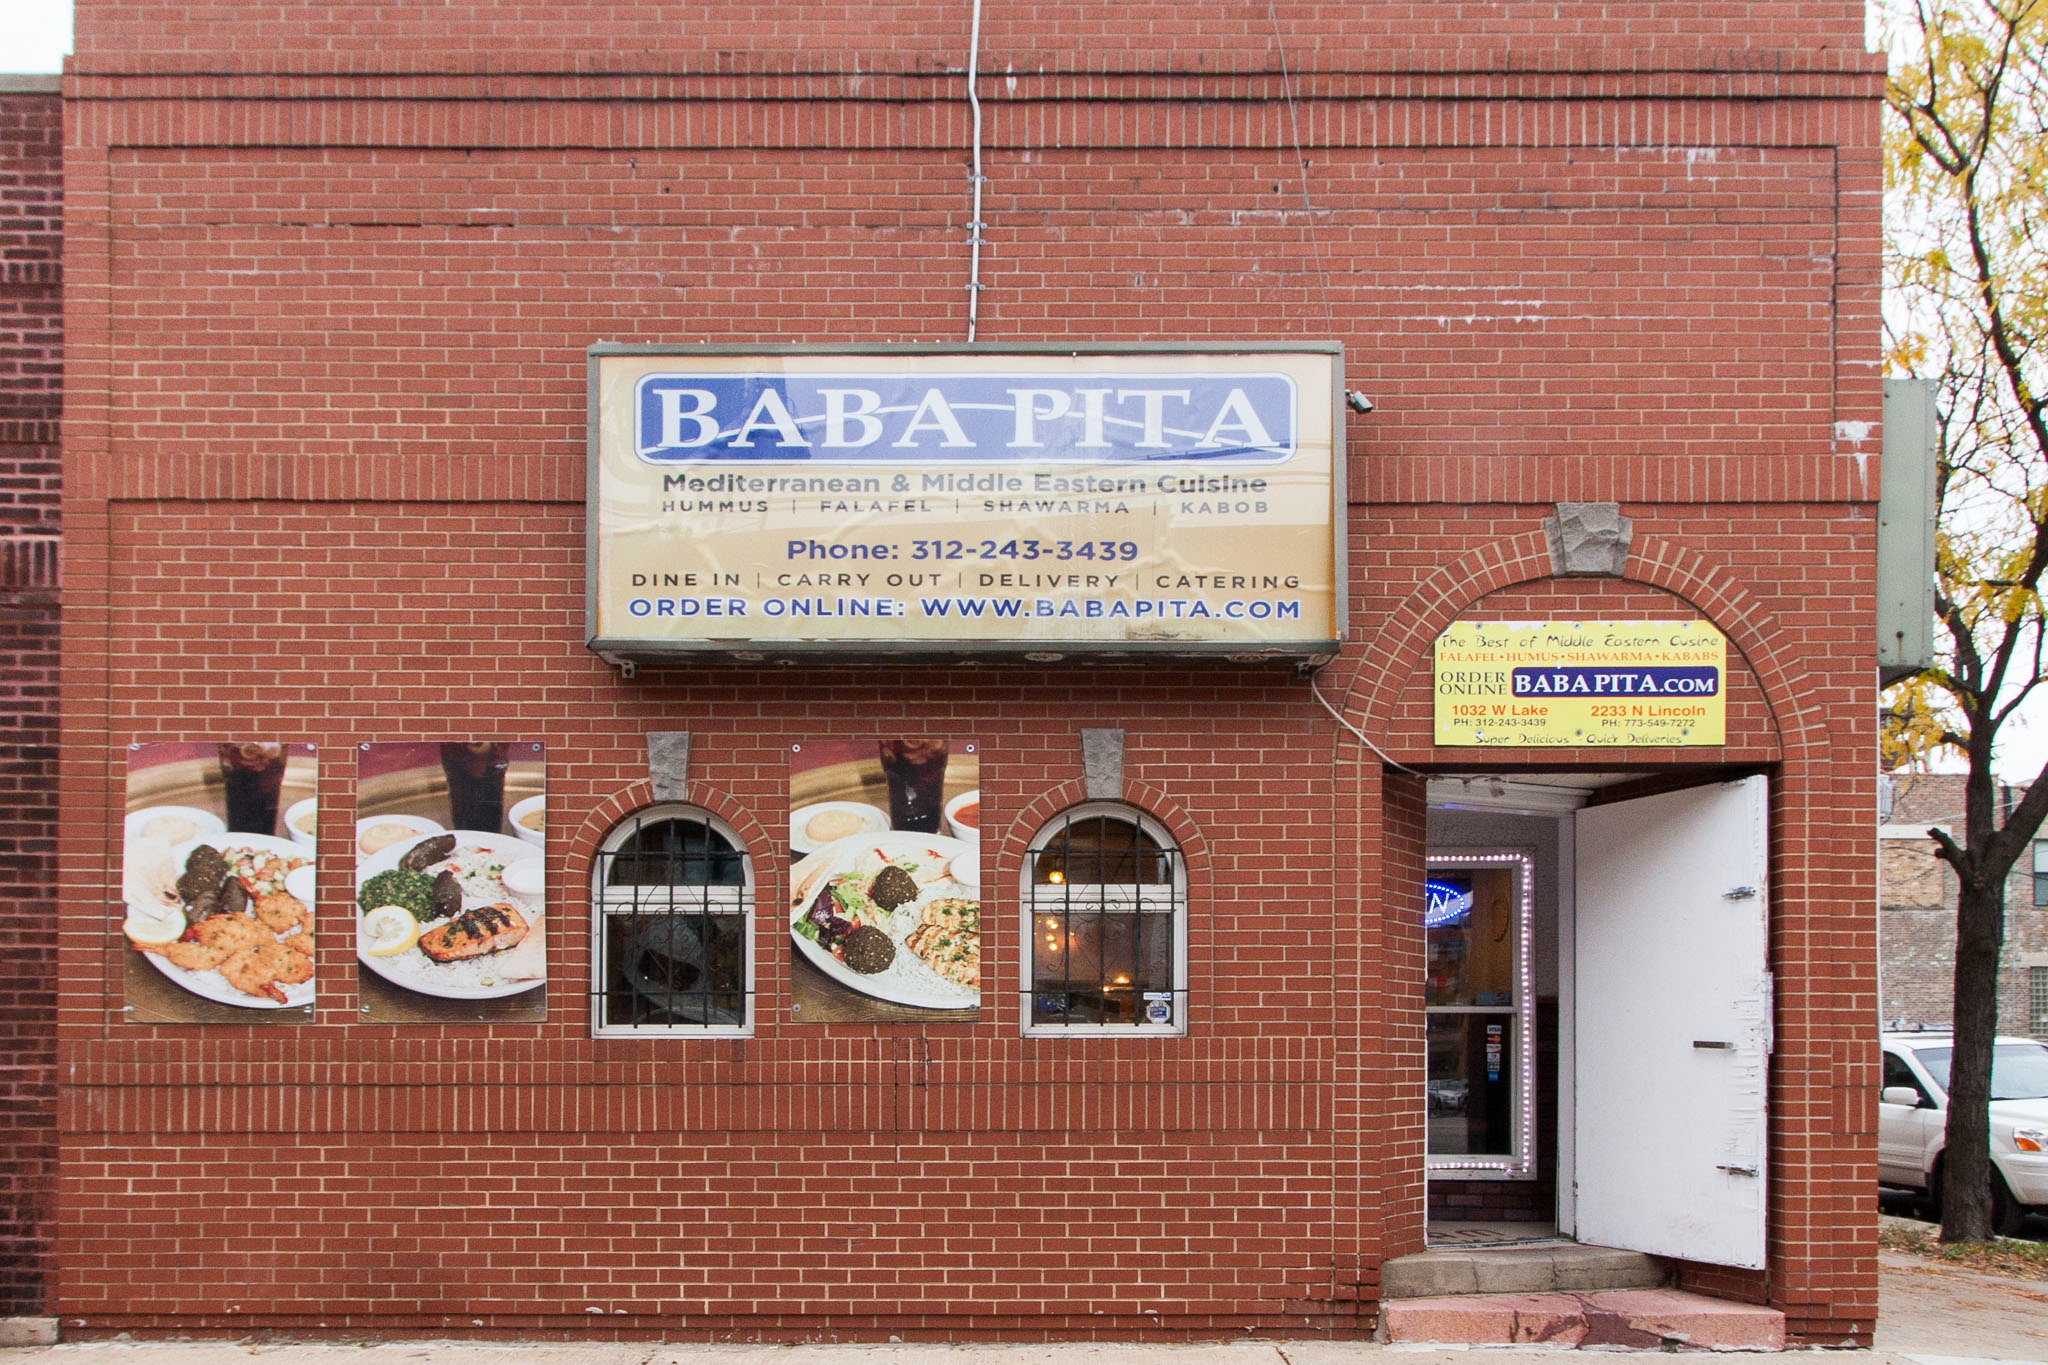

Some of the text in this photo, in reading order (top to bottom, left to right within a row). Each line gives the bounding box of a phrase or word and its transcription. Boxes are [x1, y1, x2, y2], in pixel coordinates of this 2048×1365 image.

[652, 387, 1280, 448] BABA PITA
[663, 473, 1267, 494] Mediterranean & Middle Eastern Cuisine
[662, 500, 1268, 513] HUMMUS FALAFEL SHAWARMA KABOB
[788, 540, 1138, 561] Phone: 312-243-3439
[632, 573, 1299, 589] DINE IN CARRY OUT DELIVERY CATERING
[630, 599, 1299, 619] ORDER ONLINE: WWW.BABAPITA.COM
[1441, 634, 1466, 647] The
[1476, 635, 1509, 647] Best
[1520, 635, 1537, 648] of
[1547, 635, 1593, 648] Middle
[1604, 634, 1660, 647] Eastern
[1441, 671, 1505, 683] ORDER
[1440, 684, 1507, 695] ONLINE
[1453, 704, 1548, 716] 1032 W Lake
[1591, 704, 1706, 717] 2233 N Lincoln
[1454, 718, 1546, 727] PH: 312-243-3439
[1601, 719, 1695, 728] PH: 773-549-7272
[1475, 734, 1569, 745] Super Delicious
[1587, 733, 1682, 744] Quick Deliveries
